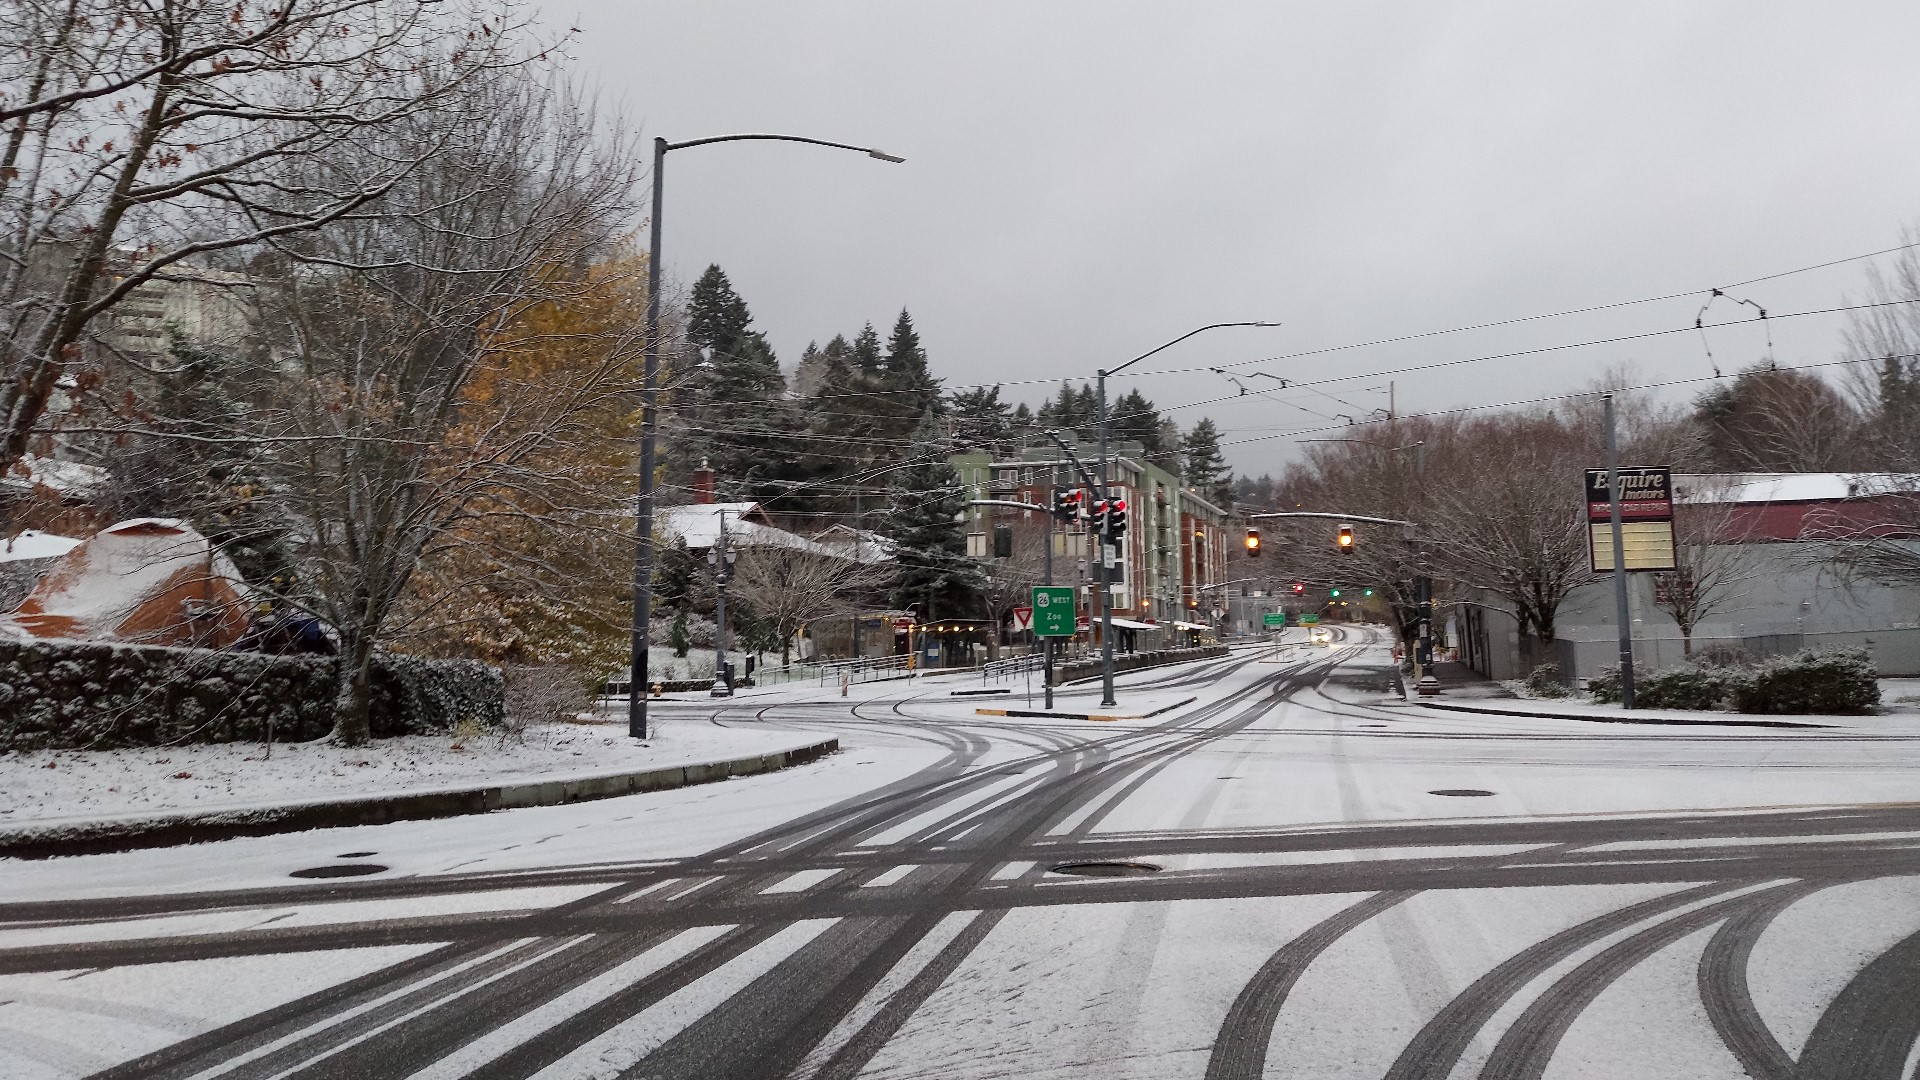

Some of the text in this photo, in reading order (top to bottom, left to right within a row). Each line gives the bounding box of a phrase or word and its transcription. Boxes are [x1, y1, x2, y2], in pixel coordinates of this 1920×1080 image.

[1593, 472, 1664, 500] Equire
[1625, 489, 1665, 500] motors
[1592, 502, 1668, 512] IMPO CAR REPAIR
[1039, 596, 1048, 604] 26
[1046, 612, 1062, 620] Zoo
